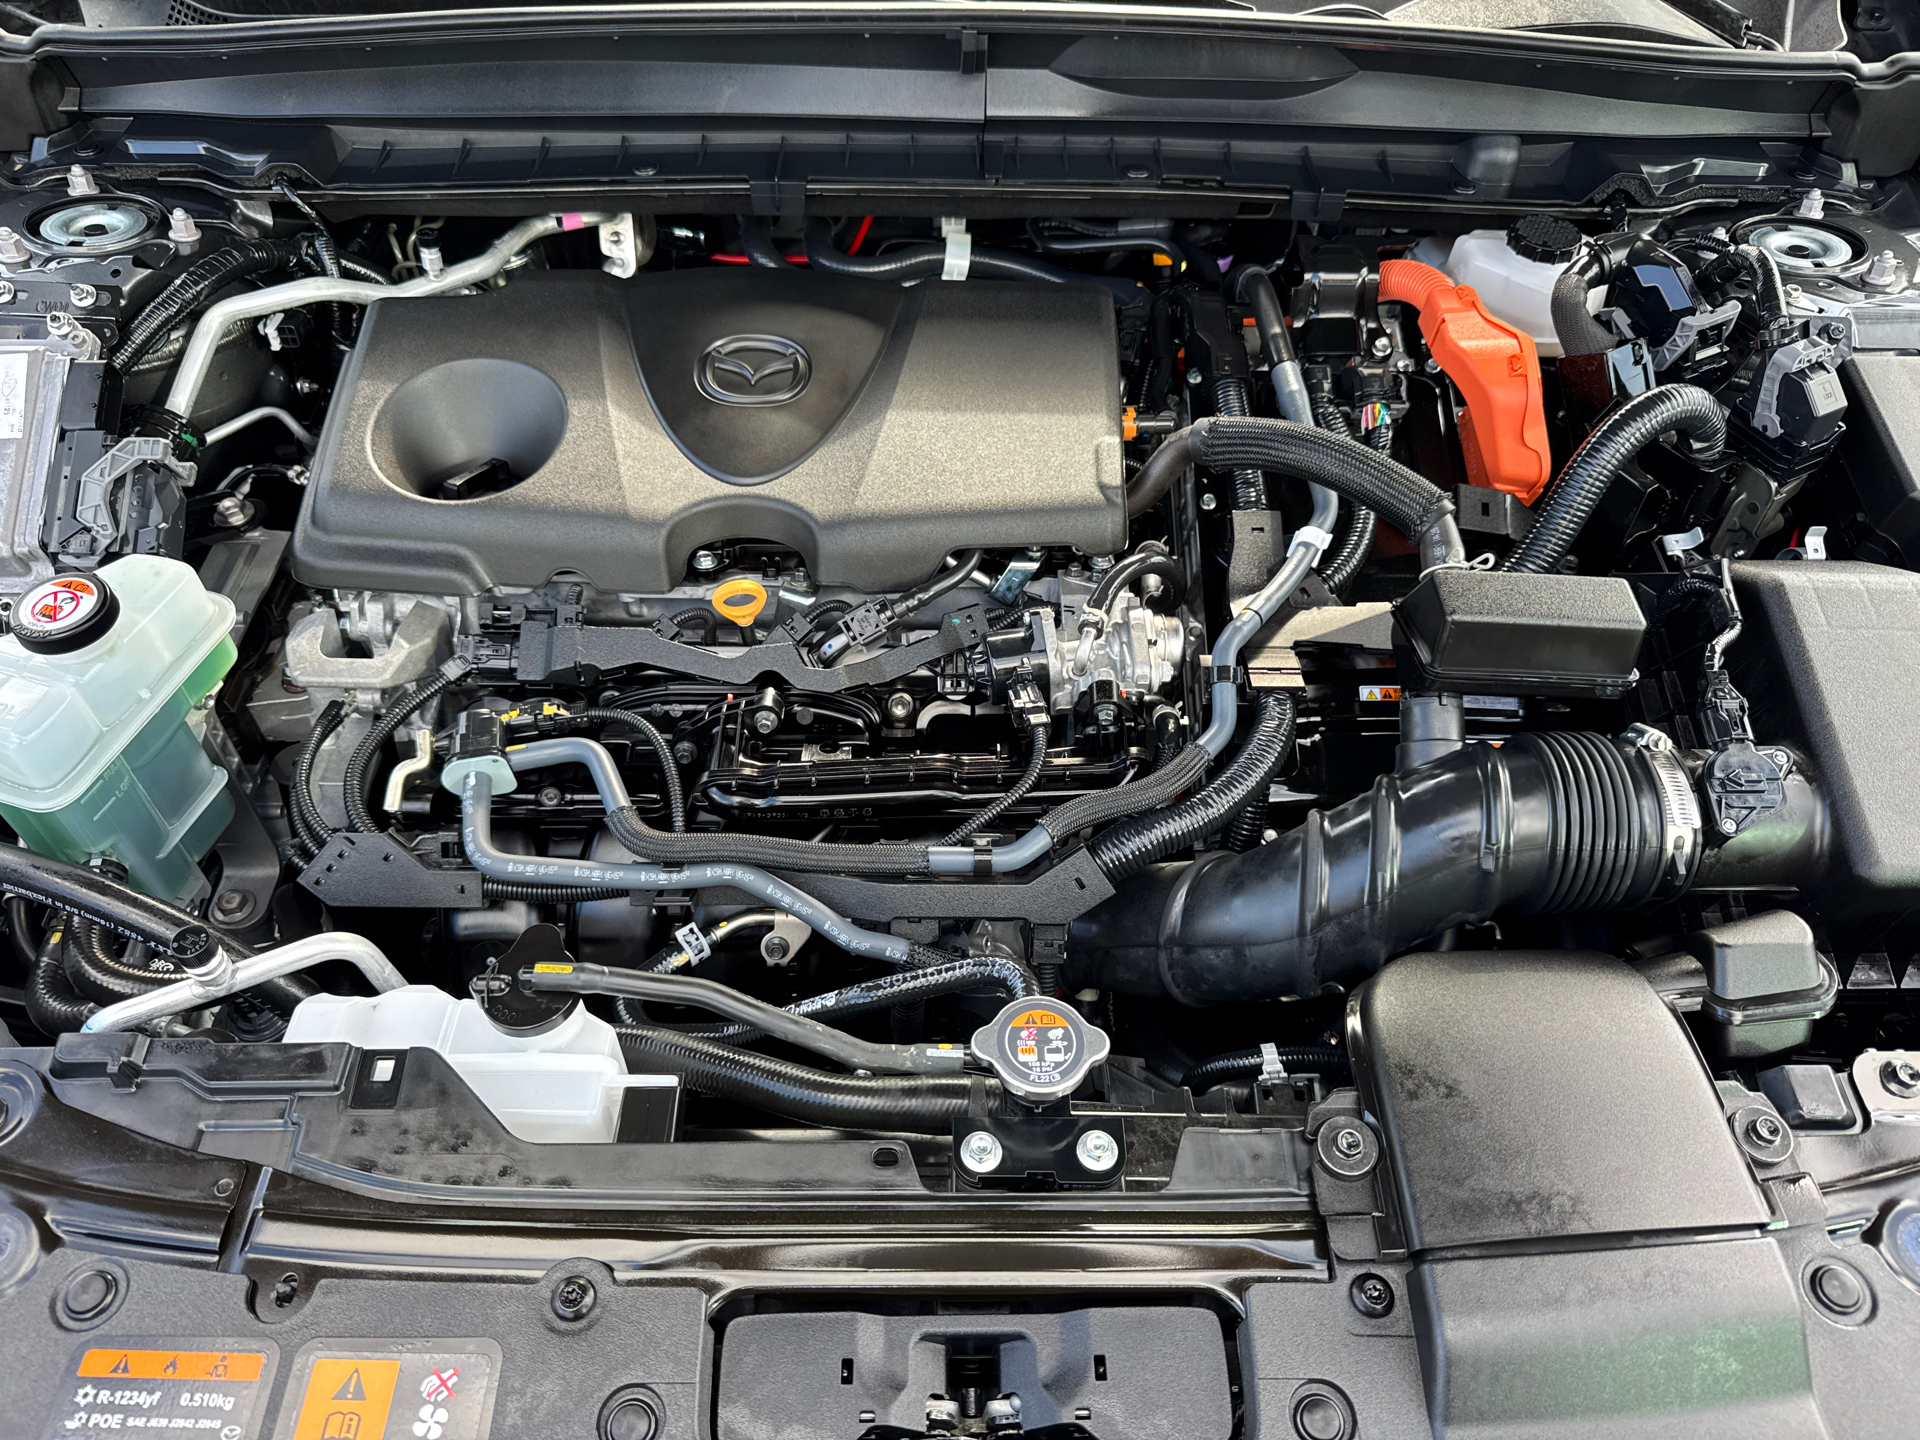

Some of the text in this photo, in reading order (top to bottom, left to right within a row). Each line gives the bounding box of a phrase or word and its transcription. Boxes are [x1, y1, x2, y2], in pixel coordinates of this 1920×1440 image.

[13, 624, 52, 639] DENSO
[2, 882, 53, 906] Flexbarrier
[54, 901, 63, 909] in
[1029, 1074, 1050, 1083] FL22
[96, 1390, 236, 1411] R-1234yf 0.510kg
[87, 1413, 124, 1429] POE
[125, 1416, 147, 1428] SAE
